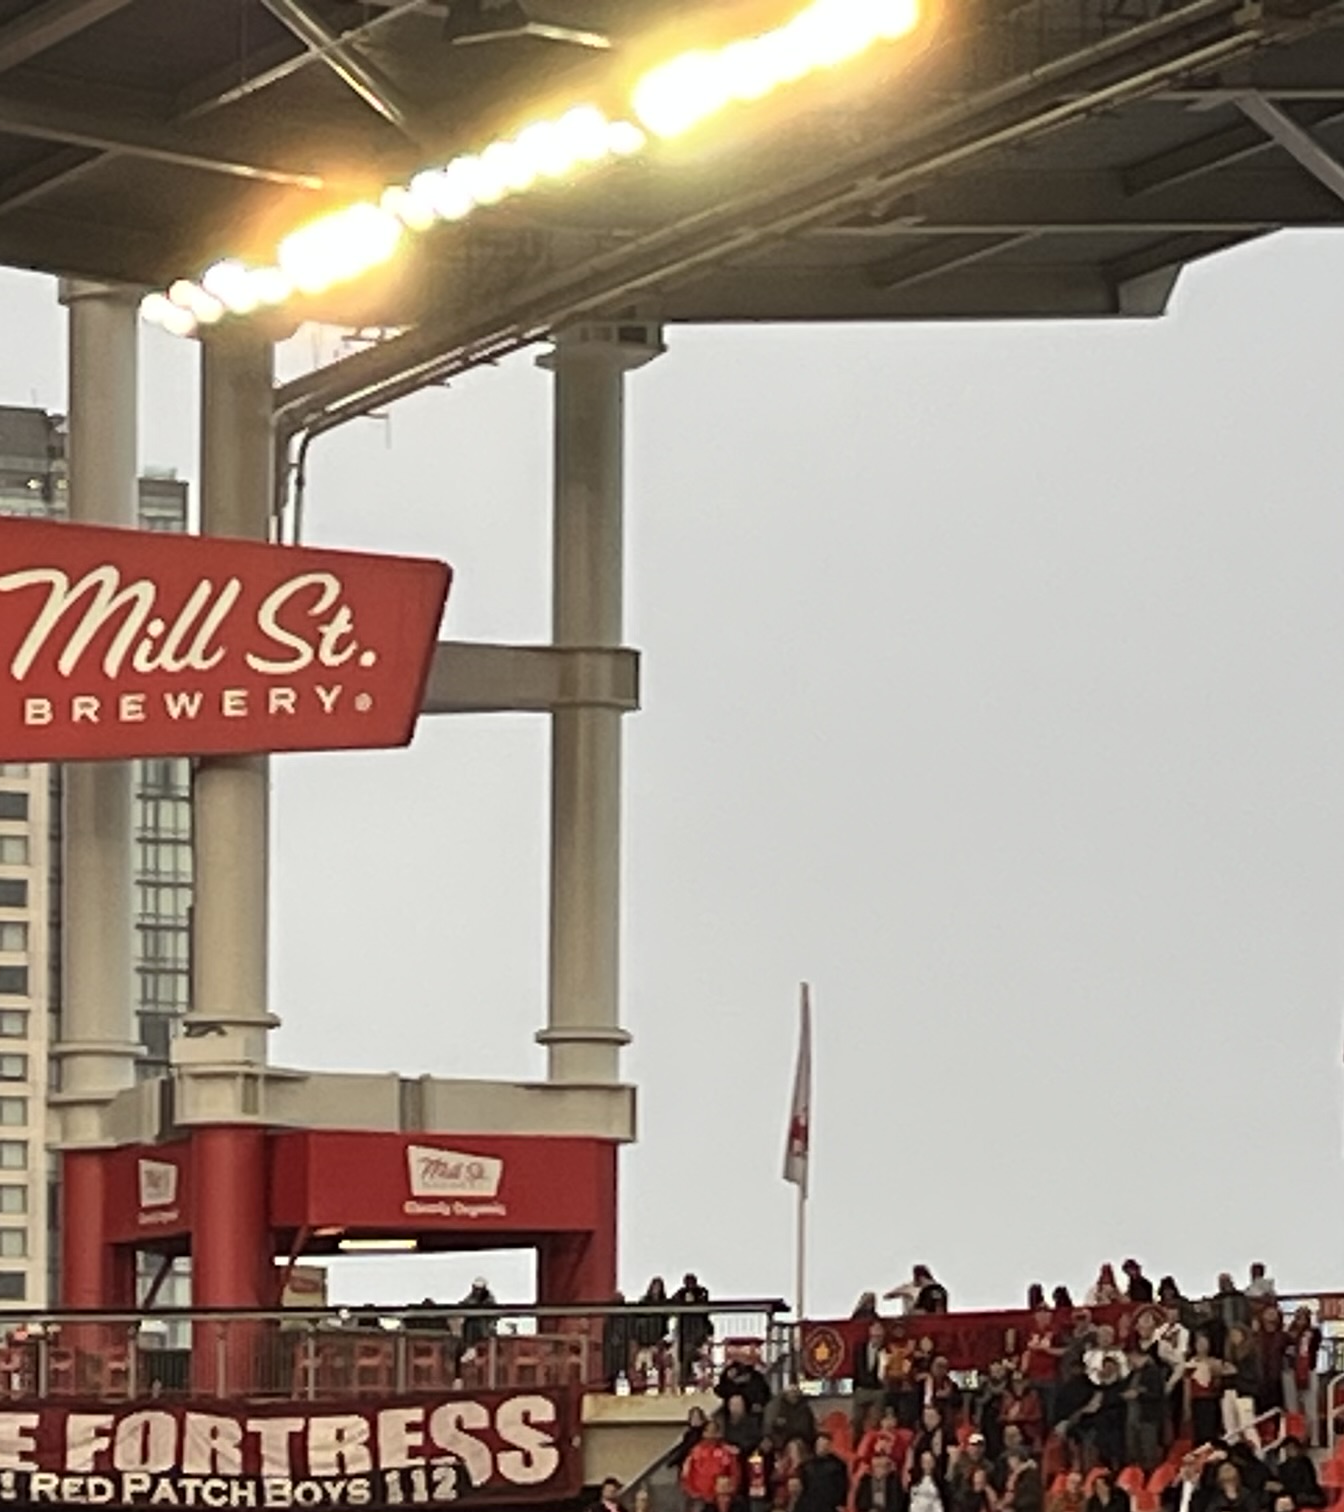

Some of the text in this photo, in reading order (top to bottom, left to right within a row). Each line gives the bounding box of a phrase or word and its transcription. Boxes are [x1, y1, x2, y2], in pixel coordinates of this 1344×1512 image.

[246, 572, 377, 675] St.
[29, 1471, 114, 1504] RED
[121, 1471, 256, 1507] PATCH
[263, 1476, 372, 1508] BOYS
[384, 1466, 457, 1504] 112
[66, 1394, 559, 1487] FORTRESS
